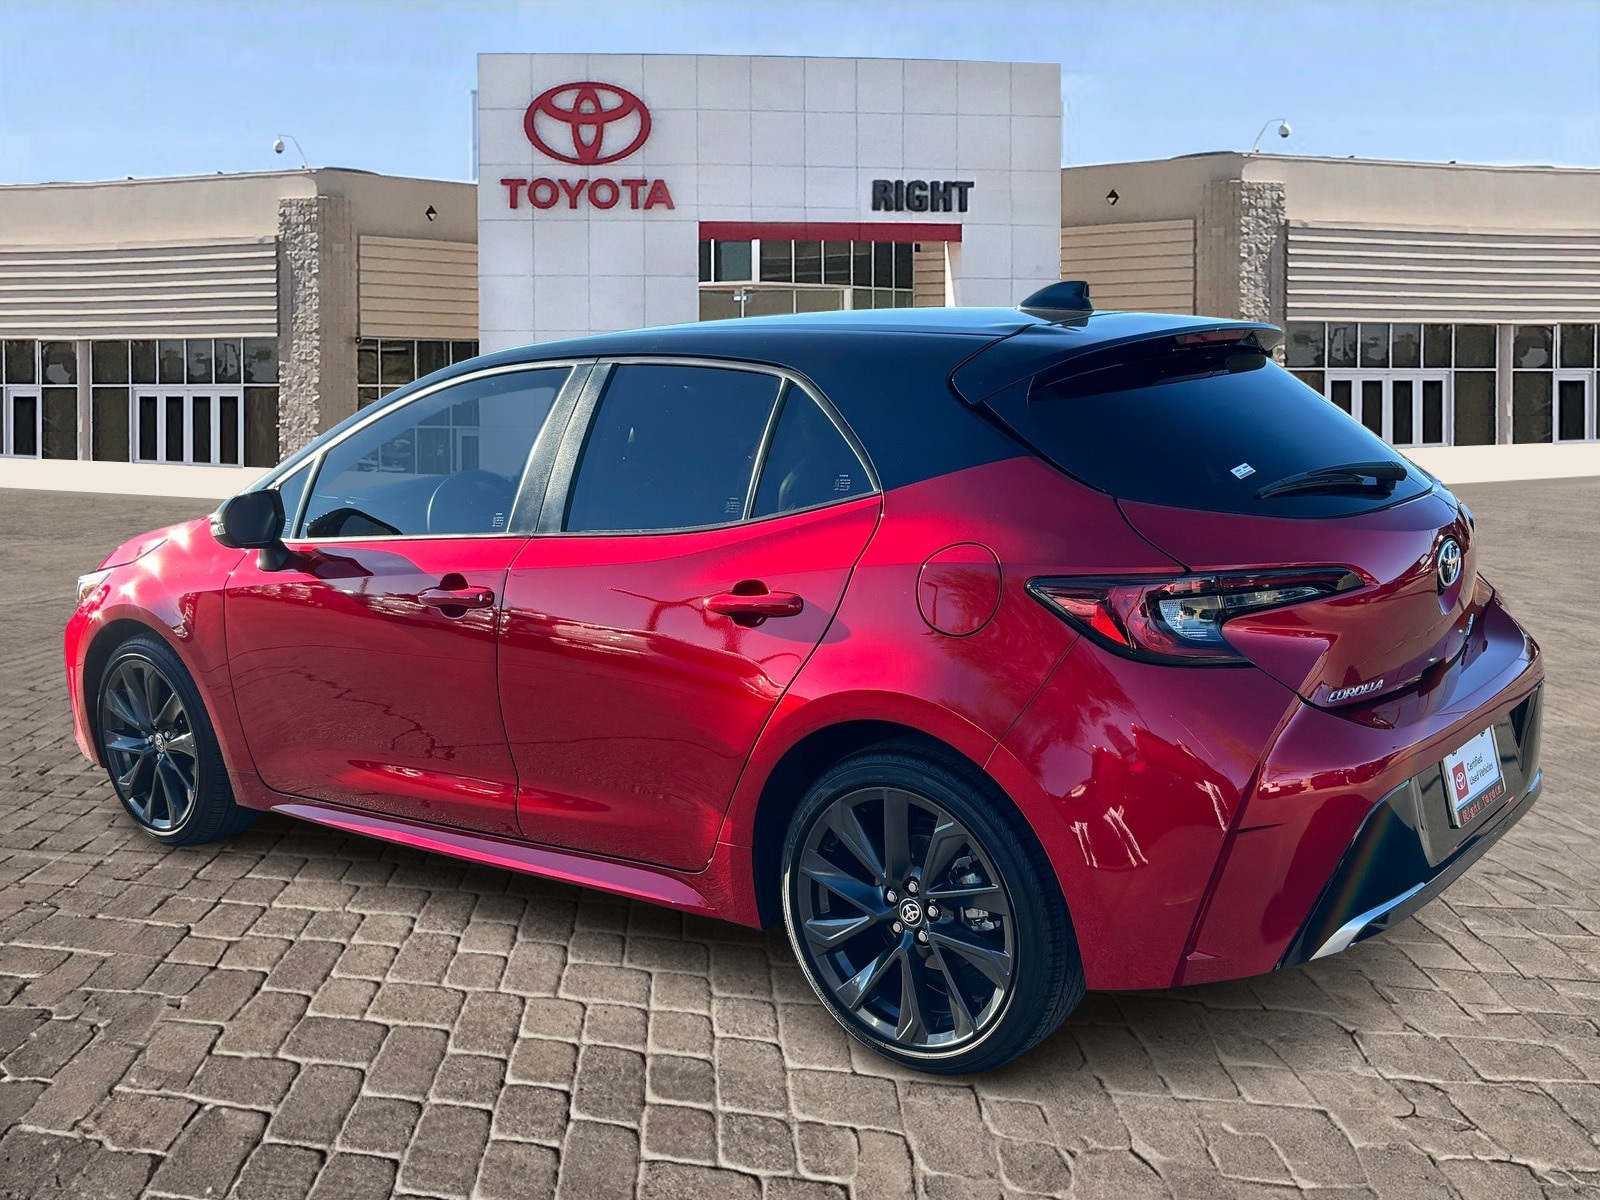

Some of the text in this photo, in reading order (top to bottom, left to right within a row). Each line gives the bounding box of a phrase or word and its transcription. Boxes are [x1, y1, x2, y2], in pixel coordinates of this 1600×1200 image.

[500, 178, 676, 210] TOYOTA
[871, 179, 975, 213] RIGHT
[1327, 679, 1384, 702] COROLLA
[1466, 753, 1484, 772] Certified
[1469, 762, 1494, 785] Used Vehicles
